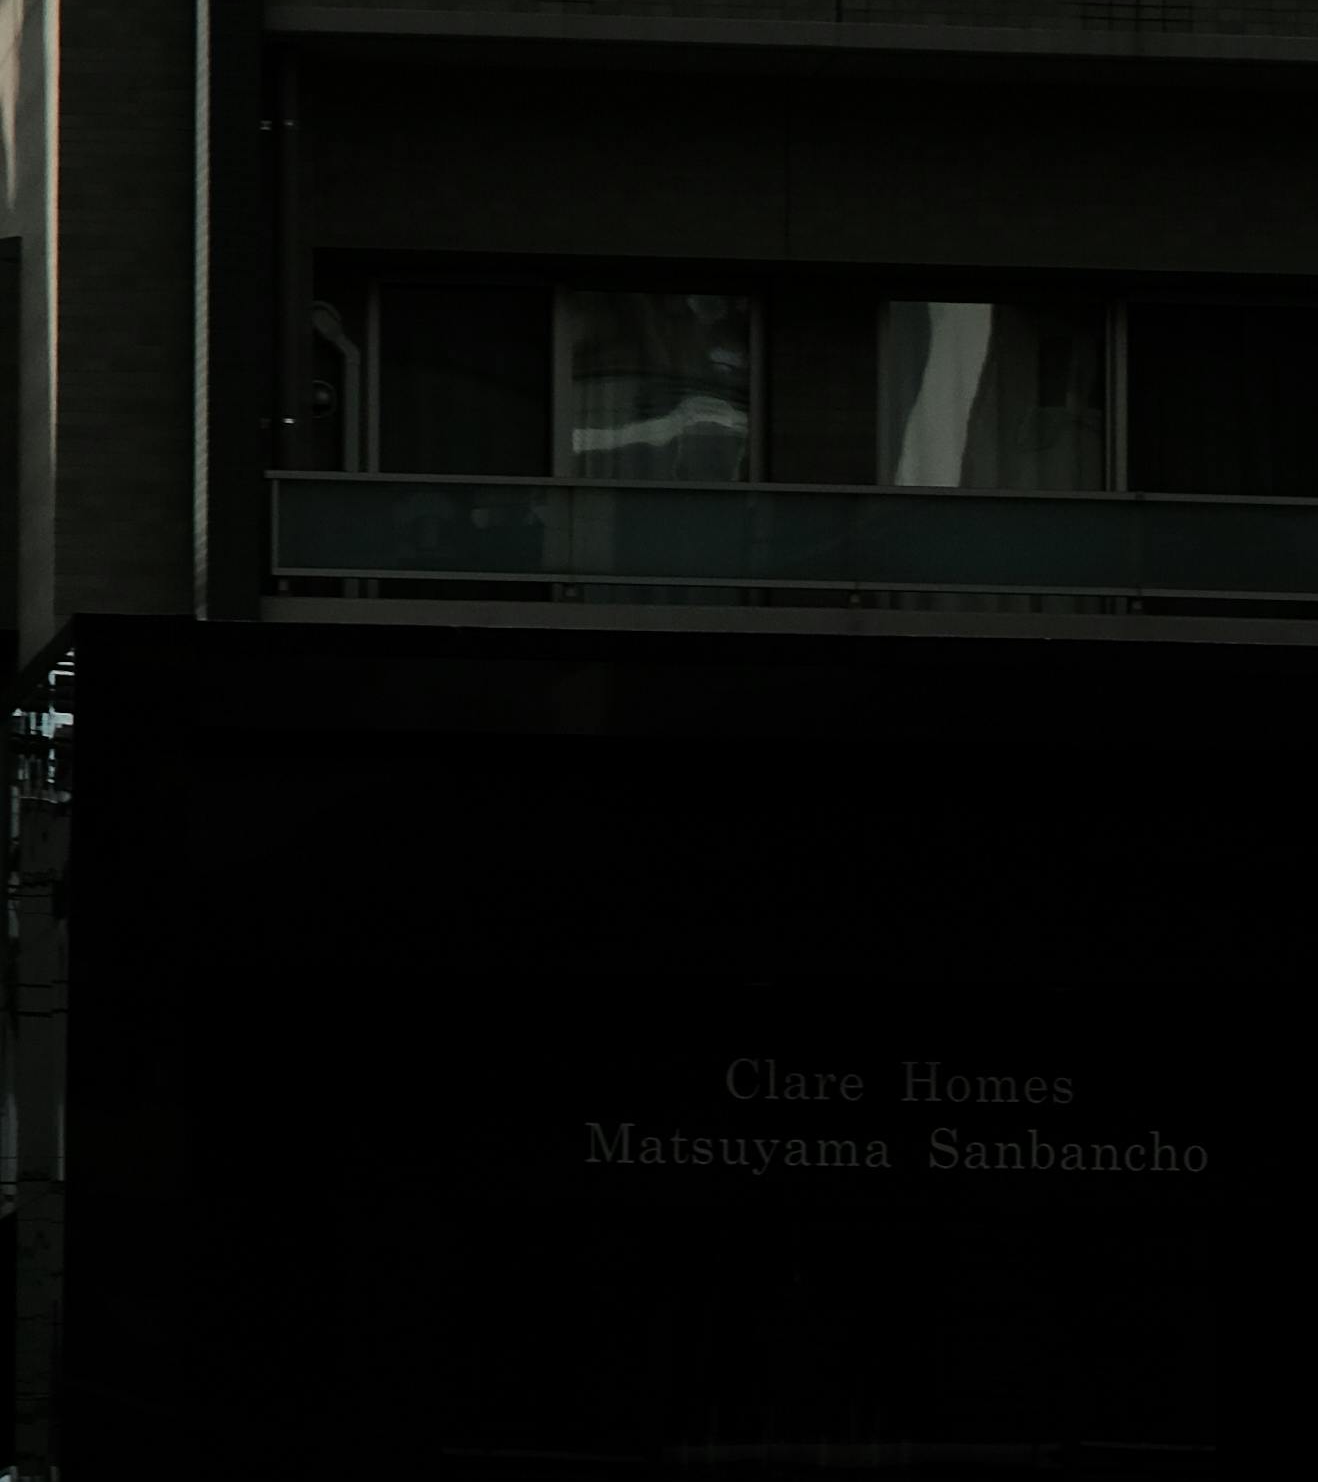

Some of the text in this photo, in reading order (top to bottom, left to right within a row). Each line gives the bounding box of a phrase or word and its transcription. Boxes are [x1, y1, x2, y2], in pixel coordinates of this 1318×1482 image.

[725, 1056, 1075, 1104] Clare Homes
[584, 1121, 1209, 1176] Matsuyama Sanbancho
